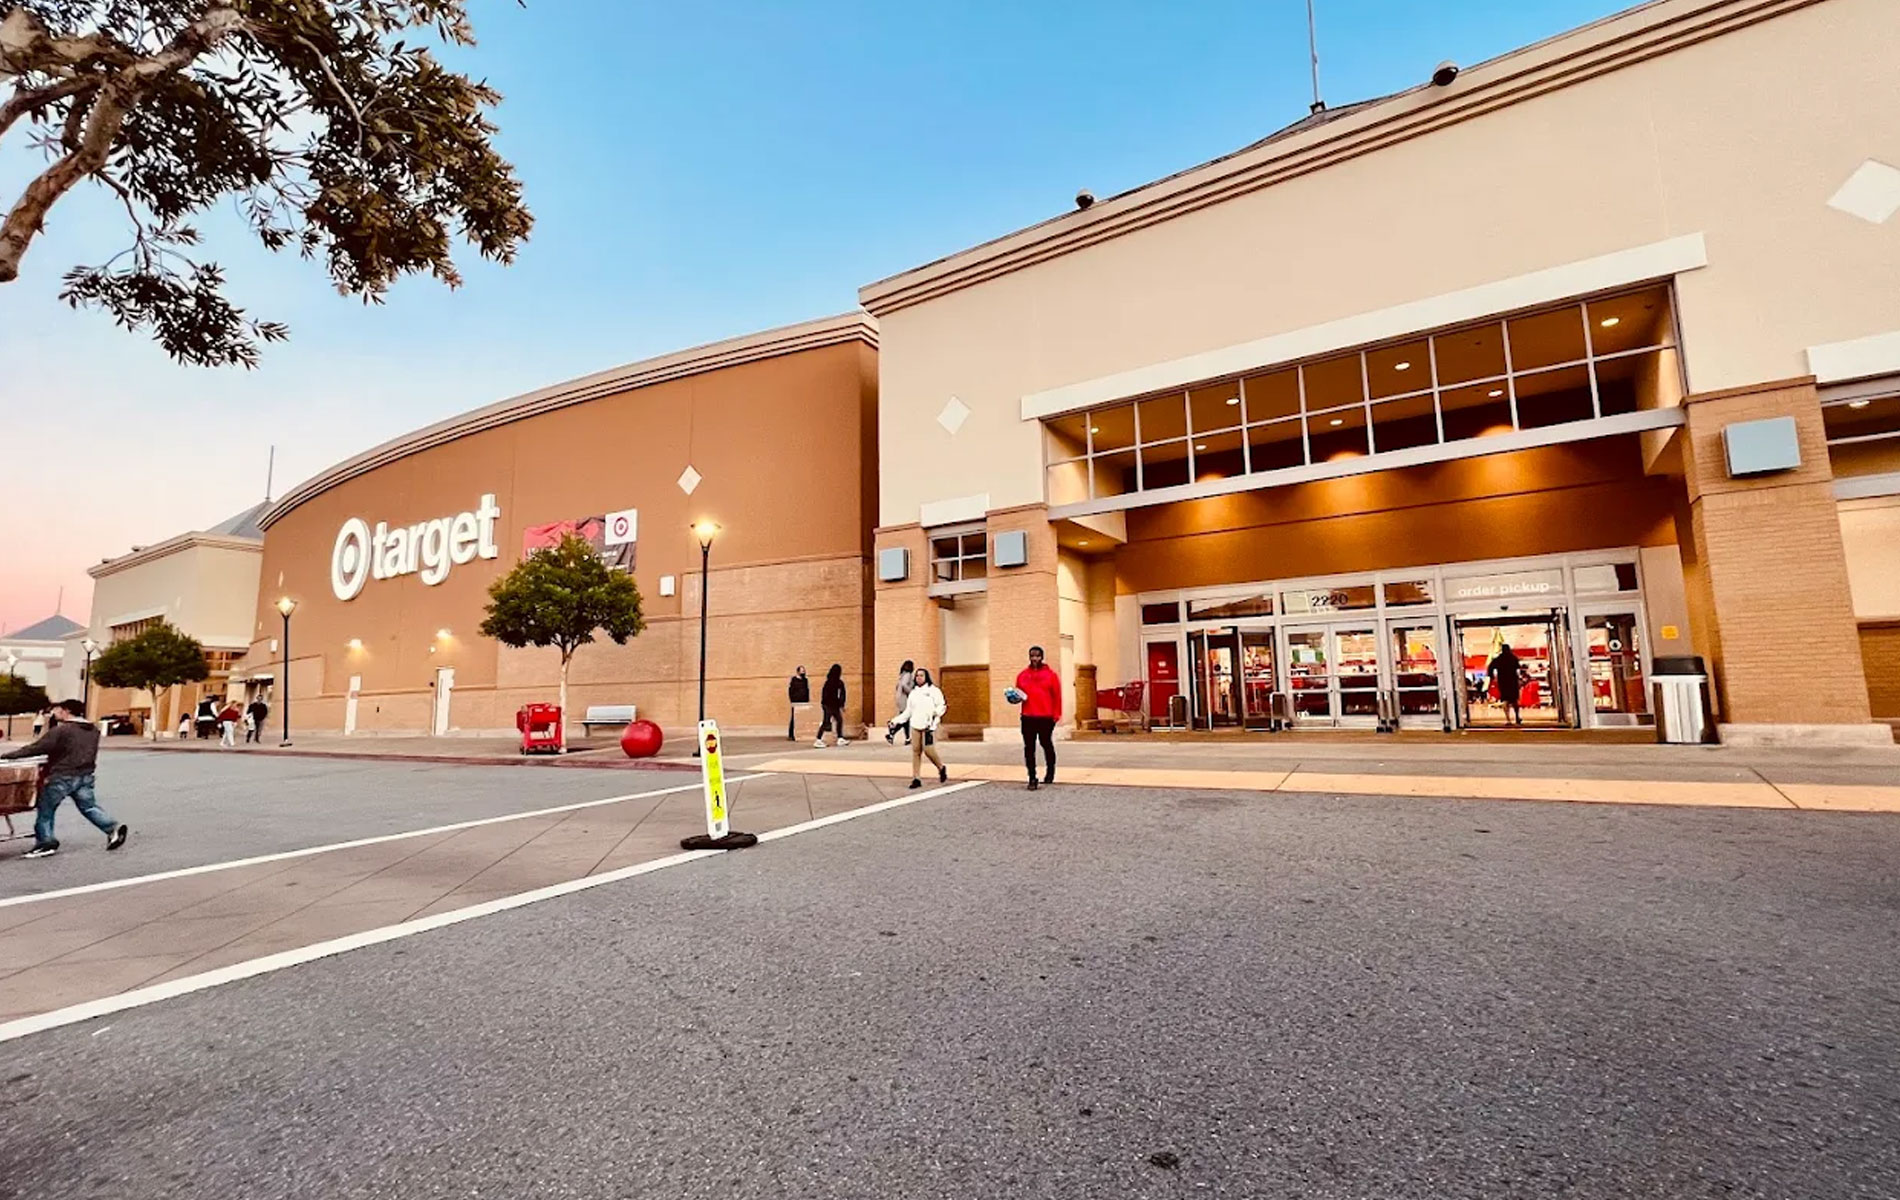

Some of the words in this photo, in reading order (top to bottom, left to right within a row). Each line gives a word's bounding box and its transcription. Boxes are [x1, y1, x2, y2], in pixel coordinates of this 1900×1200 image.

[373, 494, 500, 586] target
[1458, 585, 1497, 596] order
[1500, 582, 1550, 595] pickup
[1311, 593, 1349, 607] 2220
